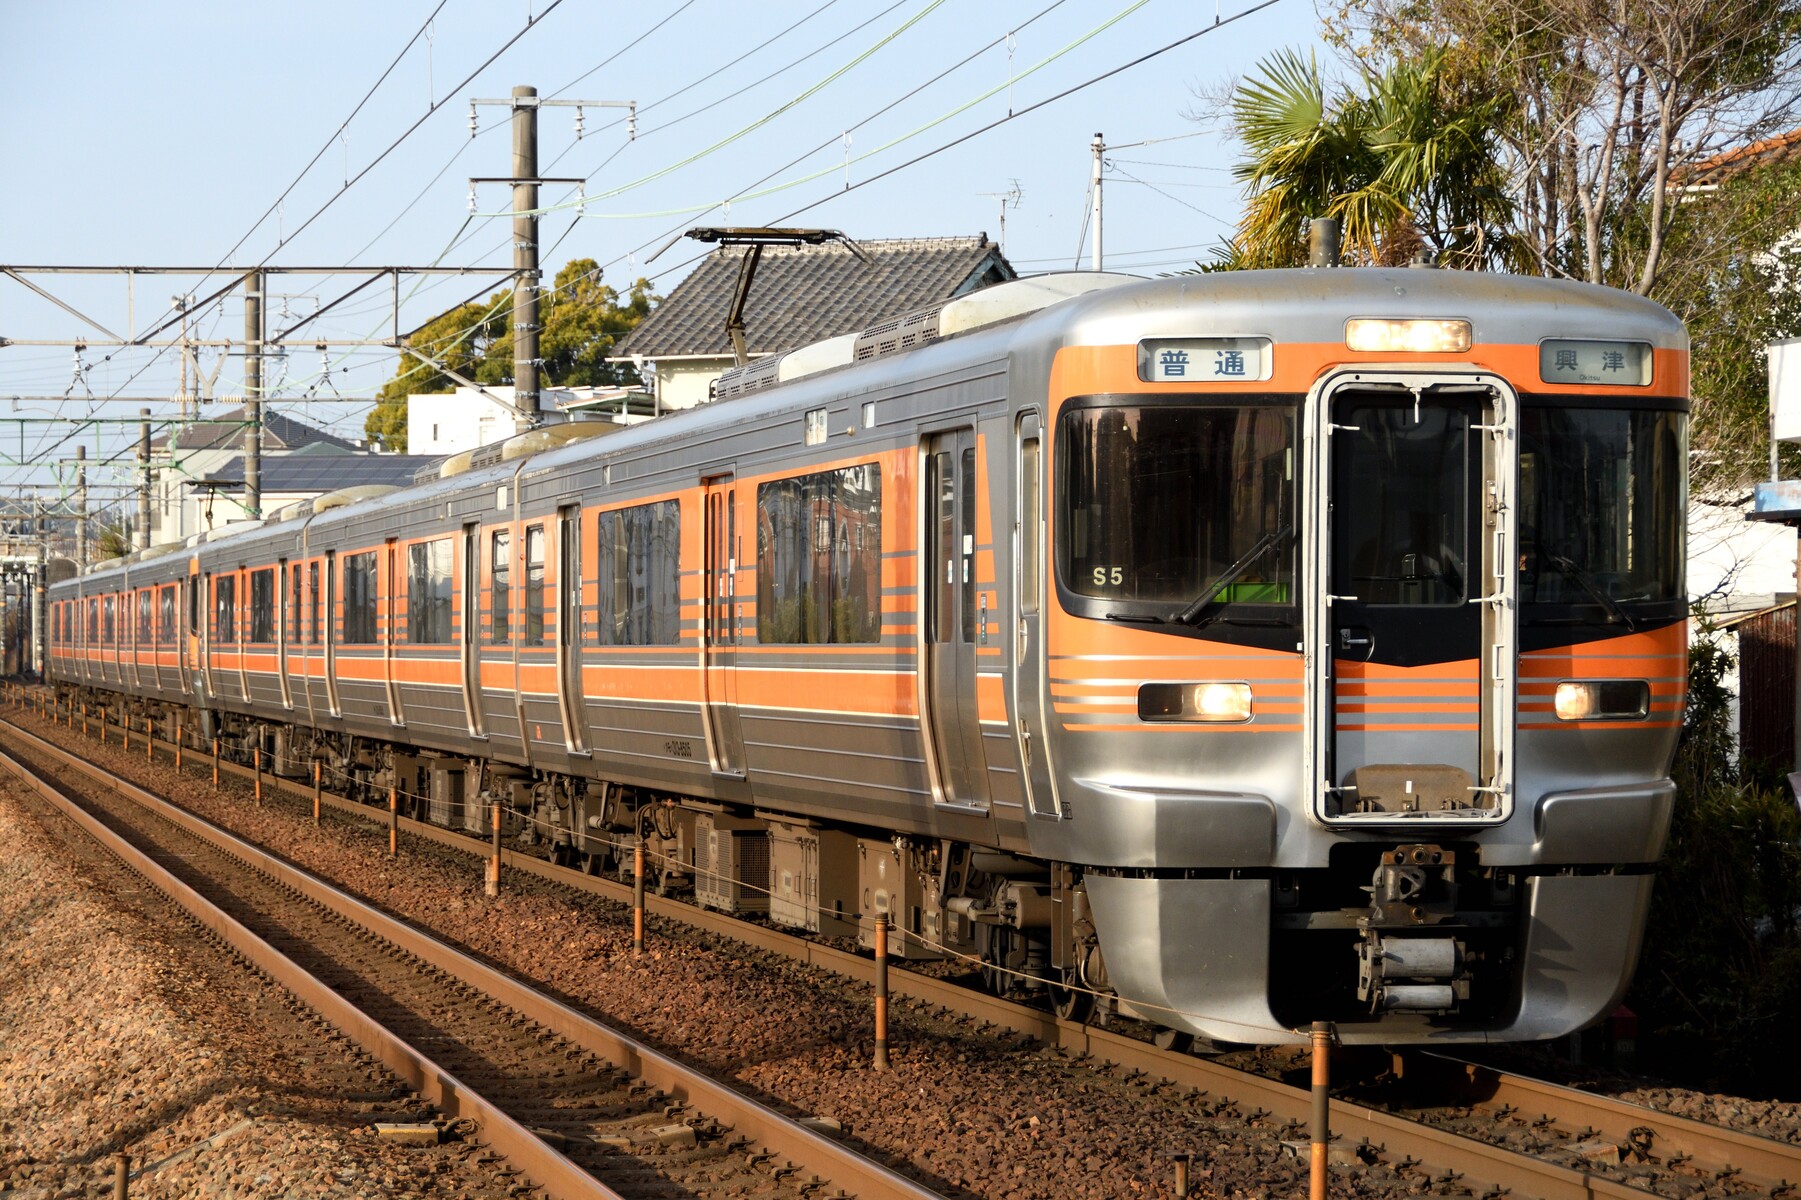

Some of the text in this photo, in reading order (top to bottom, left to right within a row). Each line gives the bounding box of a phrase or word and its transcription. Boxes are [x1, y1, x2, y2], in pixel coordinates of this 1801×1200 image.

[1159, 349, 1246, 376] 普通
[1554, 349, 1625, 373] 興津
[1093, 566, 1123, 586] S5
